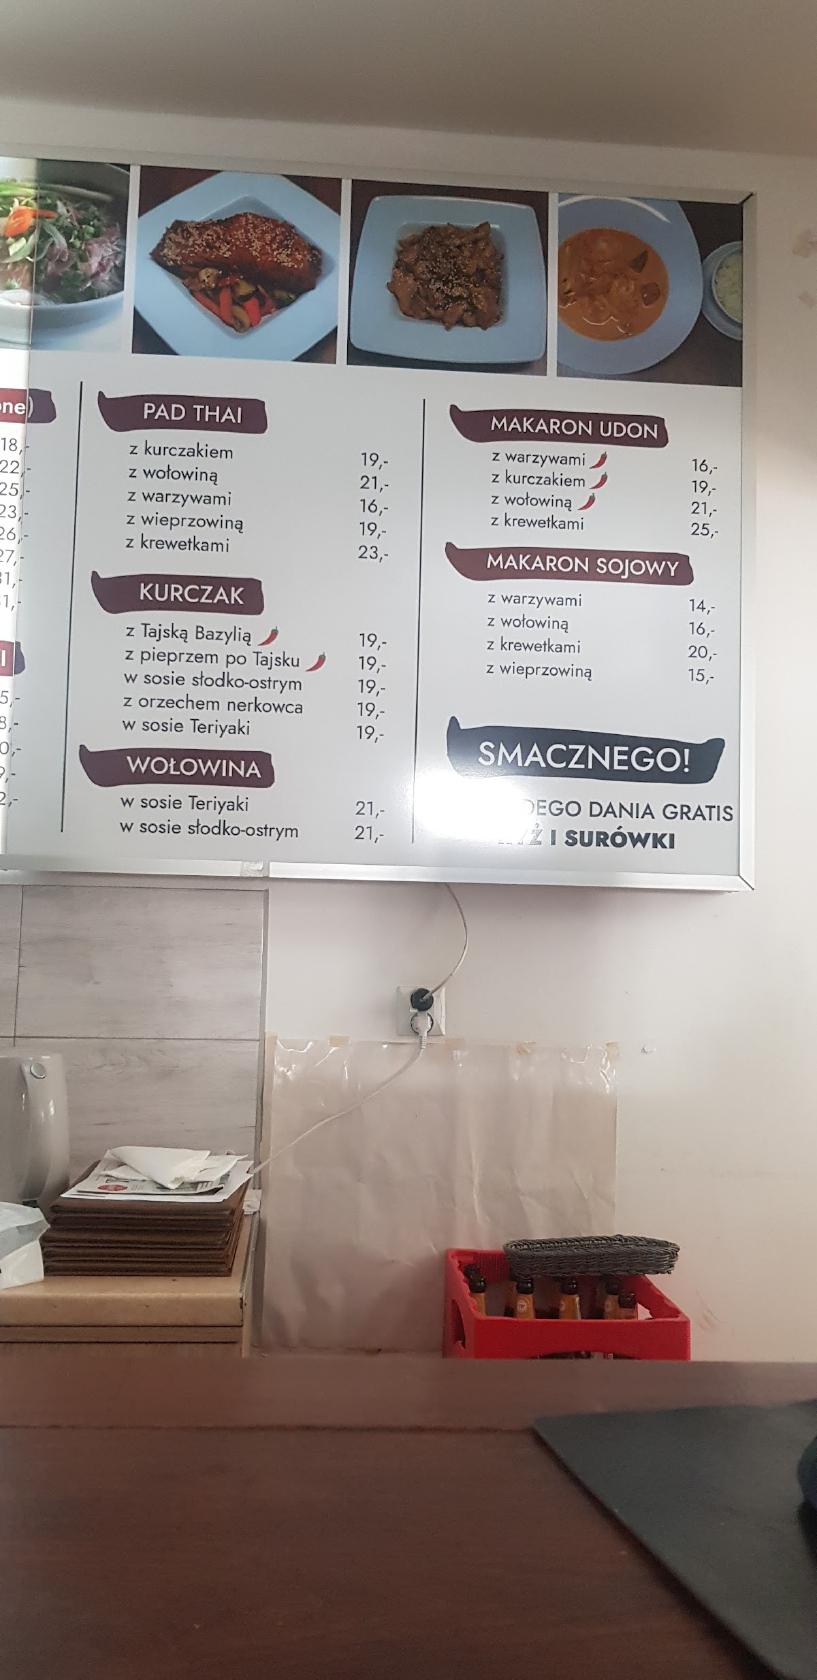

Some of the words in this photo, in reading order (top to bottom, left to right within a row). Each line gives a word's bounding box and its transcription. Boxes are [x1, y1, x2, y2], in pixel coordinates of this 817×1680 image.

[0, 396, 34, 418] ne)
[143, 403, 186, 422] PAD
[193, 405, 242, 424] THAI
[491, 416, 592, 436] MAKARON
[600, 421, 658, 439] UDON
[1, 437, 30, 455] 18,-
[129, 445, 138, 455] z
[144, 441, 234, 460] kurczakiem
[361, 452, 389, 470] 19,-
[0, 459, 31, 478] 22,-
[492, 452, 500, 462] z
[505, 452, 586, 469] warzywami
[691, 458, 718, 474] 16,-
[0, 482, 30, 500] 25,-
[128, 468, 137, 478] z
[143, 464, 219, 486] wołowiną
[360, 475, 389, 494] 21,-
[492, 473, 500, 483] z
[505, 470, 586, 488] kurczakiem
[691, 480, 716, 497] 19,-
[127, 491, 136, 502] z
[142, 491, 232, 507] warzywami
[360, 499, 389, 517] 16,-
[491, 495, 499, 505] z
[505, 492, 572, 512] wołowiną
[691, 502, 717, 518] 21,-
[126, 514, 135, 525] z
[141, 513, 244, 534] wieprzowiną
[359, 522, 387, 539] 19,-
[491, 517, 499, 526] z
[504, 513, 584, 530] krewetkami
[690, 523, 719, 539] 25,-
[125, 538, 134, 548] z
[140, 534, 230, 553] krewetkami
[358, 545, 389, 563] 23,-
[487, 553, 589, 573] MAKARON
[596, 558, 679, 579] SOJOWY
[0, 571, 23, 589] 1,-
[139, 583, 245, 605] KURCZAK
[488, 593, 496, 603] z
[501, 593, 582, 609] warzywami
[689, 599, 715, 615] 14,-
[126, 627, 135, 637] z
[141, 623, 188, 644] Tajską
[195, 626, 252, 646] Bazylią
[359, 633, 387, 651] 19,-
[487, 617, 495, 627] z
[501, 614, 569, 633] wołowiną
[689, 622, 715, 638] 16,-
[125, 650, 134, 661] z
[140, 649, 218, 669] pieprzem
[226, 654, 247, 673] po
[252, 651, 300, 671] Tajsku
[359, 656, 387, 674] 19,-
[487, 640, 494, 650] z
[500, 636, 581, 654] krewetkami
[688, 645, 717, 662] 20,-
[124, 673, 138, 683] w
[144, 671, 186, 686] sosie
[192, 671, 302, 694] słodko-ostrym
[358, 679, 386, 697] 19,-
[486, 664, 494, 674] z
[500, 662, 592, 681] wieprzowiną
[688, 668, 715, 685] 15,-
[123, 696, 132, 707] z
[138, 693, 220, 712] orzechem
[227, 696, 303, 714] nerkowca
[357, 702, 385, 720] 19,-
[122, 720, 136, 730] w
[142, 717, 184, 733] sosie
[190, 718, 250, 738] Teriyaki
[357, 725, 384, 743] 19,-
[127, 756, 262, 778] WOŁOWINA
[478, 741, 690, 773] SMACZNEGO!
[120, 797, 134, 808] w
[140, 795, 182, 810] sosie
[188, 795, 249, 815] Teriyaki
[355, 801, 385, 818] 21,-
[589, 801, 655, 819] DANIA
[662, 803, 734, 822] GRATIS
[120, 821, 134, 832] w
[139, 819, 181, 834] sosie
[188, 819, 299, 842] słodko-ostrym
[355, 825, 385, 844] 21,-
[551, 829, 556, 846] I
[564, 825, 675, 849] SURÓWKI
